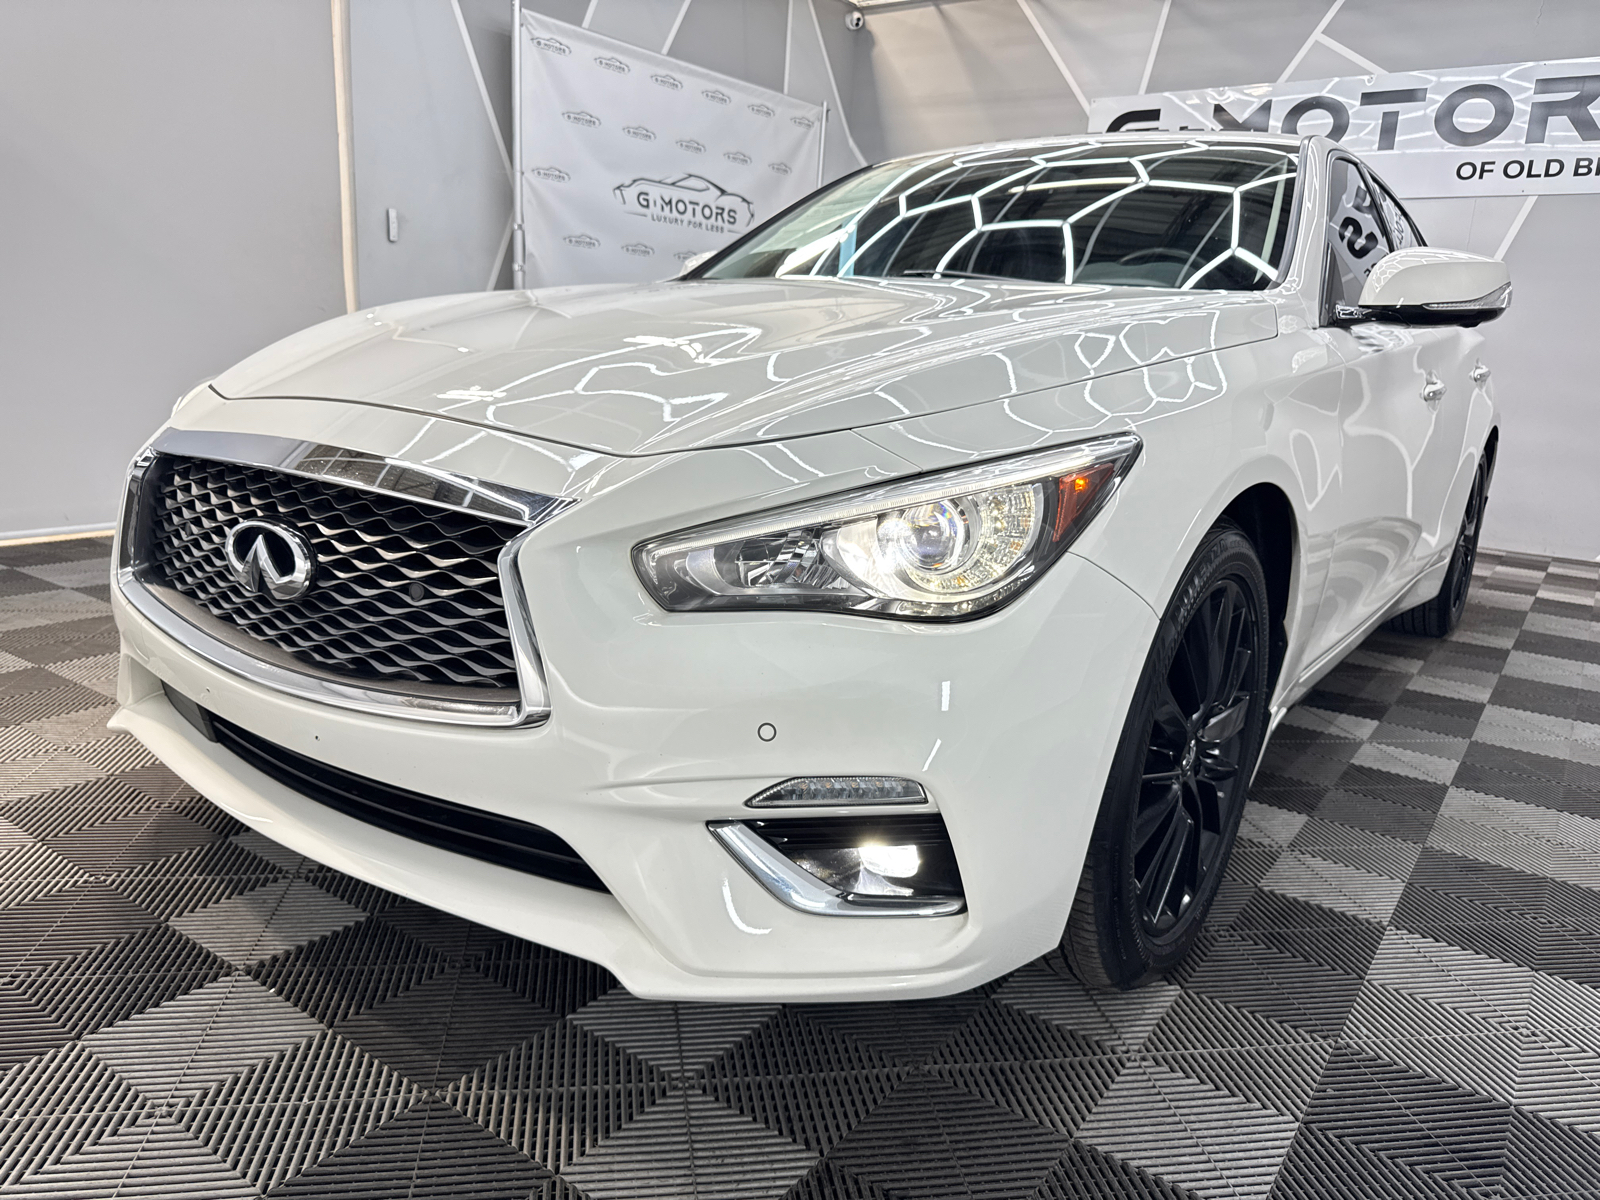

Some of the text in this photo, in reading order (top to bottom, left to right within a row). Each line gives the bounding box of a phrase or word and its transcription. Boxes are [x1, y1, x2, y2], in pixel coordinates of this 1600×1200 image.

[1455, 160, 1496, 181] OF
[1502, 157, 1566, 180] OLD
[650, 212, 725, 234] LUXURY FOR LESS
